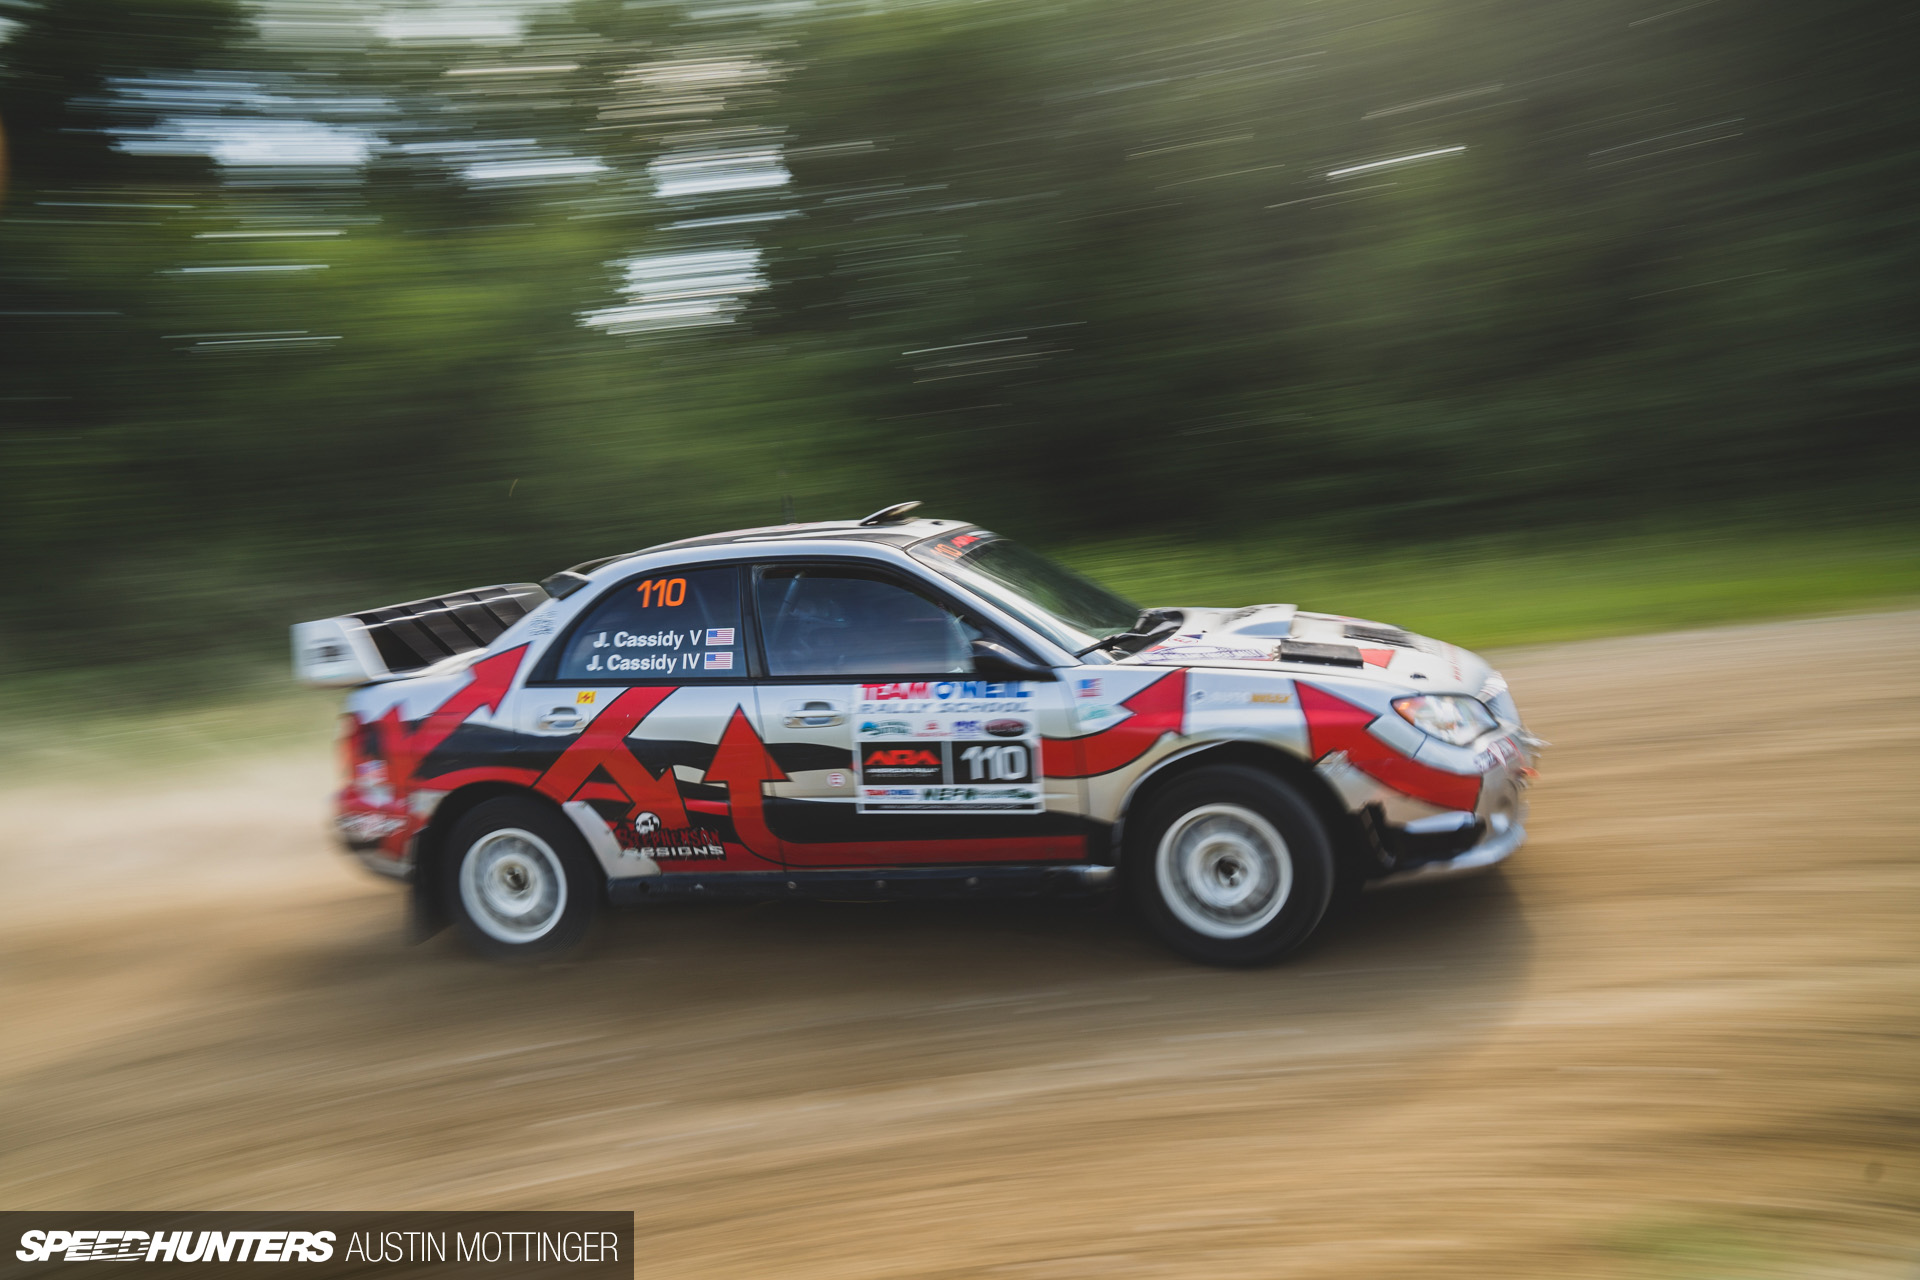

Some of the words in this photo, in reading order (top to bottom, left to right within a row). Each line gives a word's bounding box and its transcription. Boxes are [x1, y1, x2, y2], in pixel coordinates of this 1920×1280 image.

[636, 578, 687, 608] 110
[593, 631, 610, 648] J.
[614, 630, 684, 650] Cassidy
[689, 630, 702, 646] V
[586, 655, 603, 671] J.
[607, 654, 677, 674] Cassidy
[682, 653, 700, 669] IV
[860, 682, 931, 700] TEAM
[938, 701, 1035, 713] SCHOOL
[863, 749, 942, 766] ARA
[959, 745, 1029, 780] 110
